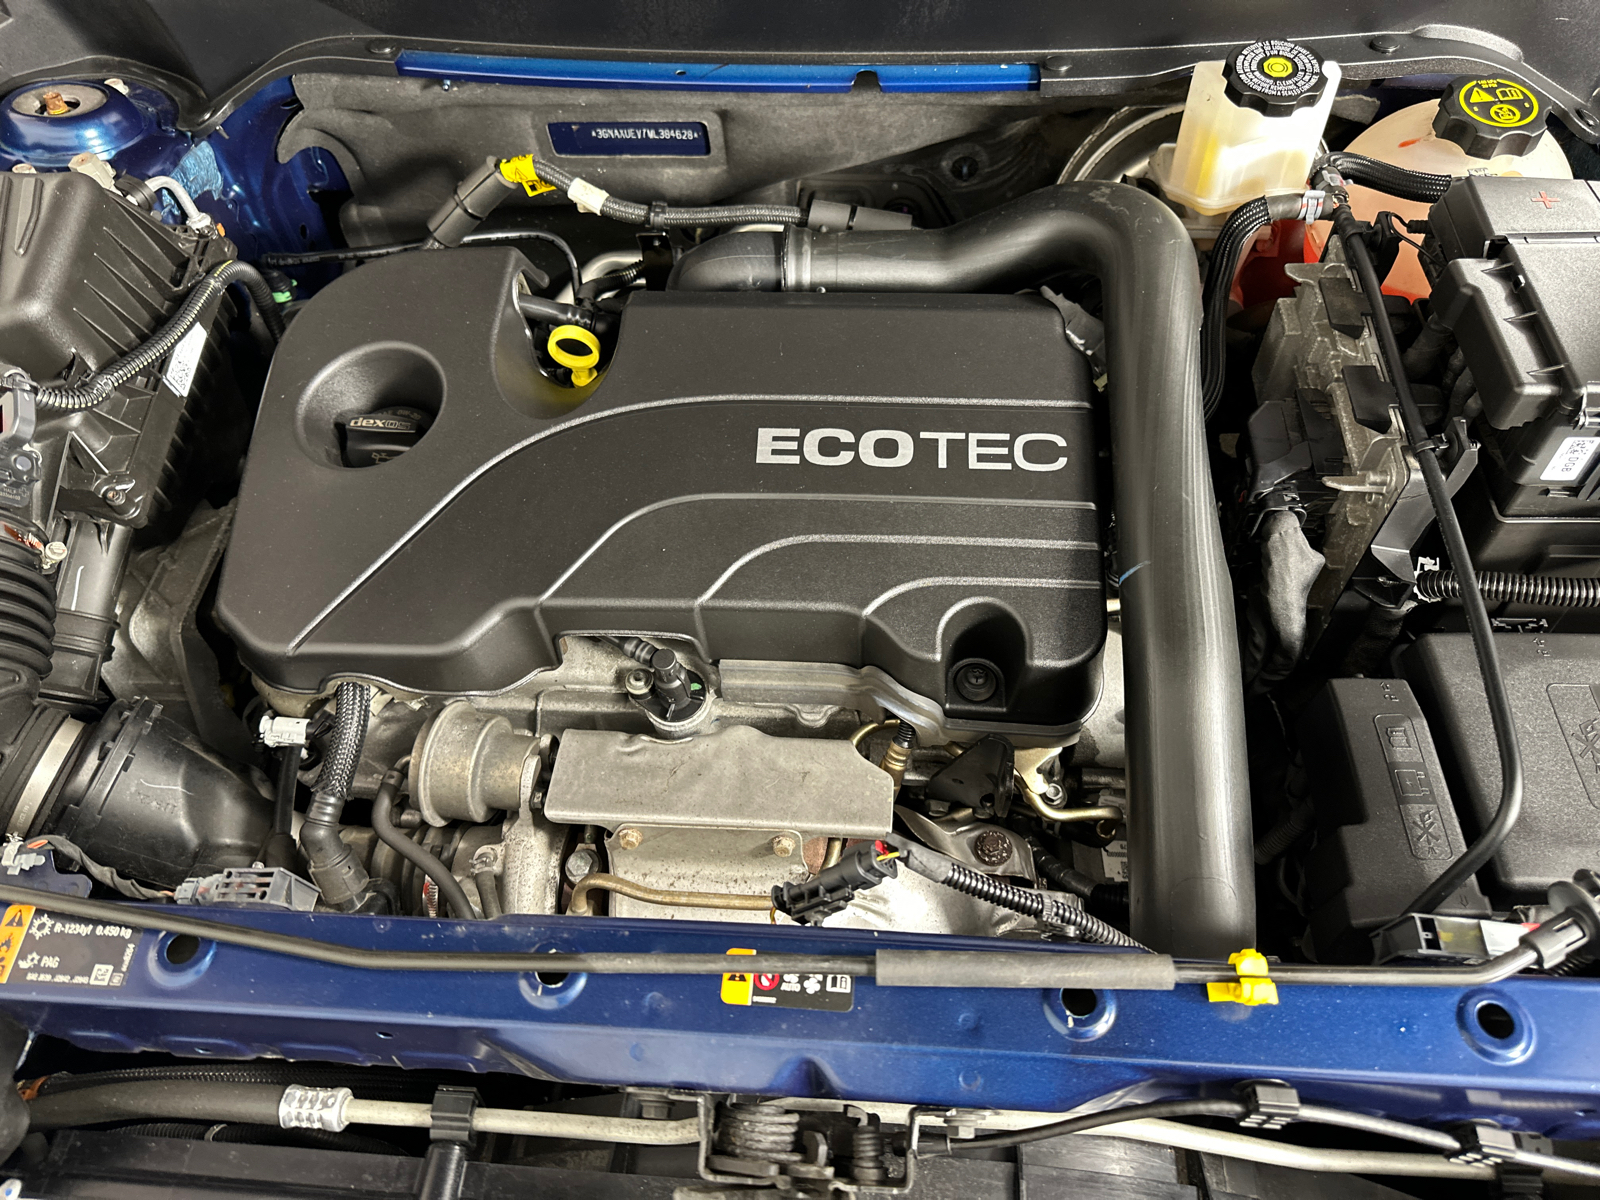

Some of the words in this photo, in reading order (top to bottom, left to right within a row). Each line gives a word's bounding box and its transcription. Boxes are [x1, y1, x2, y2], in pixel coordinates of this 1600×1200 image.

[755, 427, 1068, 472] ECOTEC
[53, 922, 94, 937] R-1234yf
[120, 927, 133, 939] kg
[40, 955, 61, 968] PAG
[780, 982, 801, 992] AUTO
